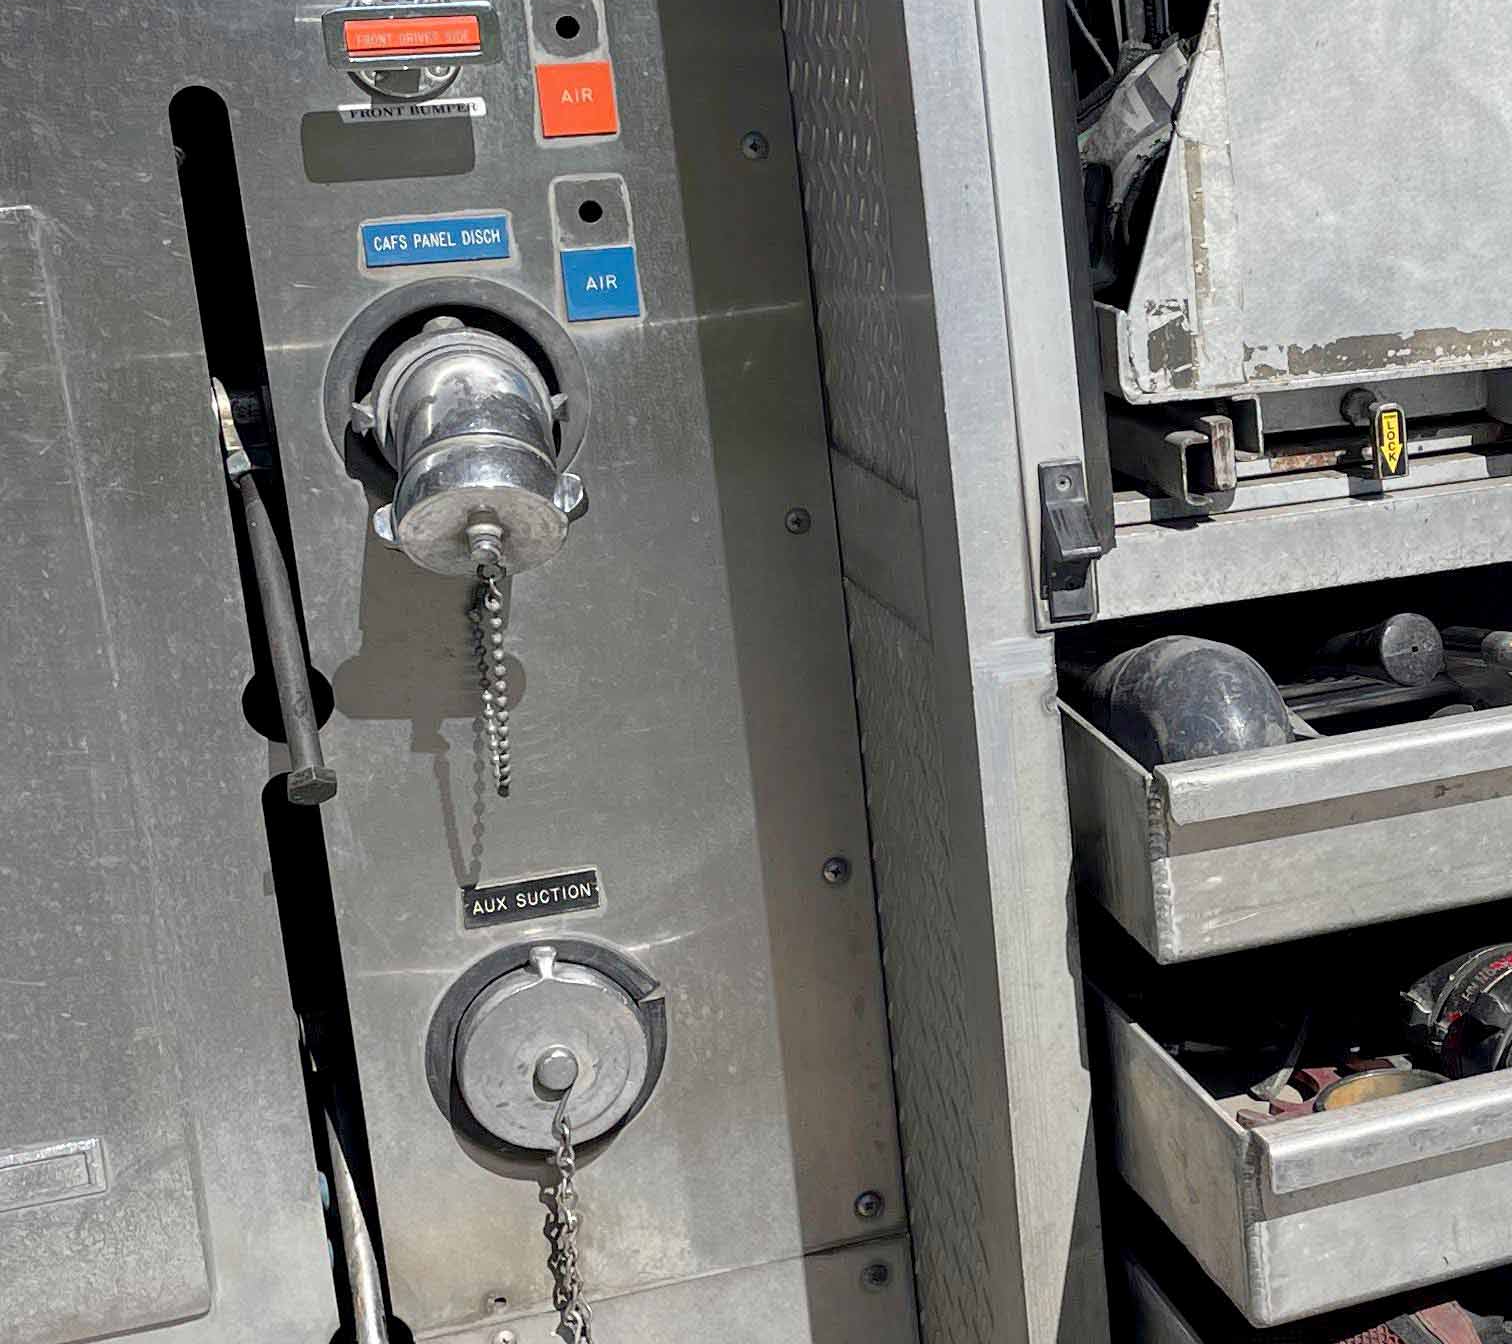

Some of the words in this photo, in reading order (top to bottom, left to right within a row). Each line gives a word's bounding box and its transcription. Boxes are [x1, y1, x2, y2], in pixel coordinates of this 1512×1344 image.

[560, 87, 593, 104] AIR
[349, 106, 402, 120] FRONT
[409, 102, 479, 117] BUMPER
[374, 234, 408, 252] CAFS
[413, 231, 457, 250] PANEL
[462, 228, 501, 246] DISCH
[585, 275, 619, 292] AIR
[1386, 420, 1397, 462] LOCK
[472, 895, 509, 916] AUX
[515, 882, 592, 909] SUCTION
